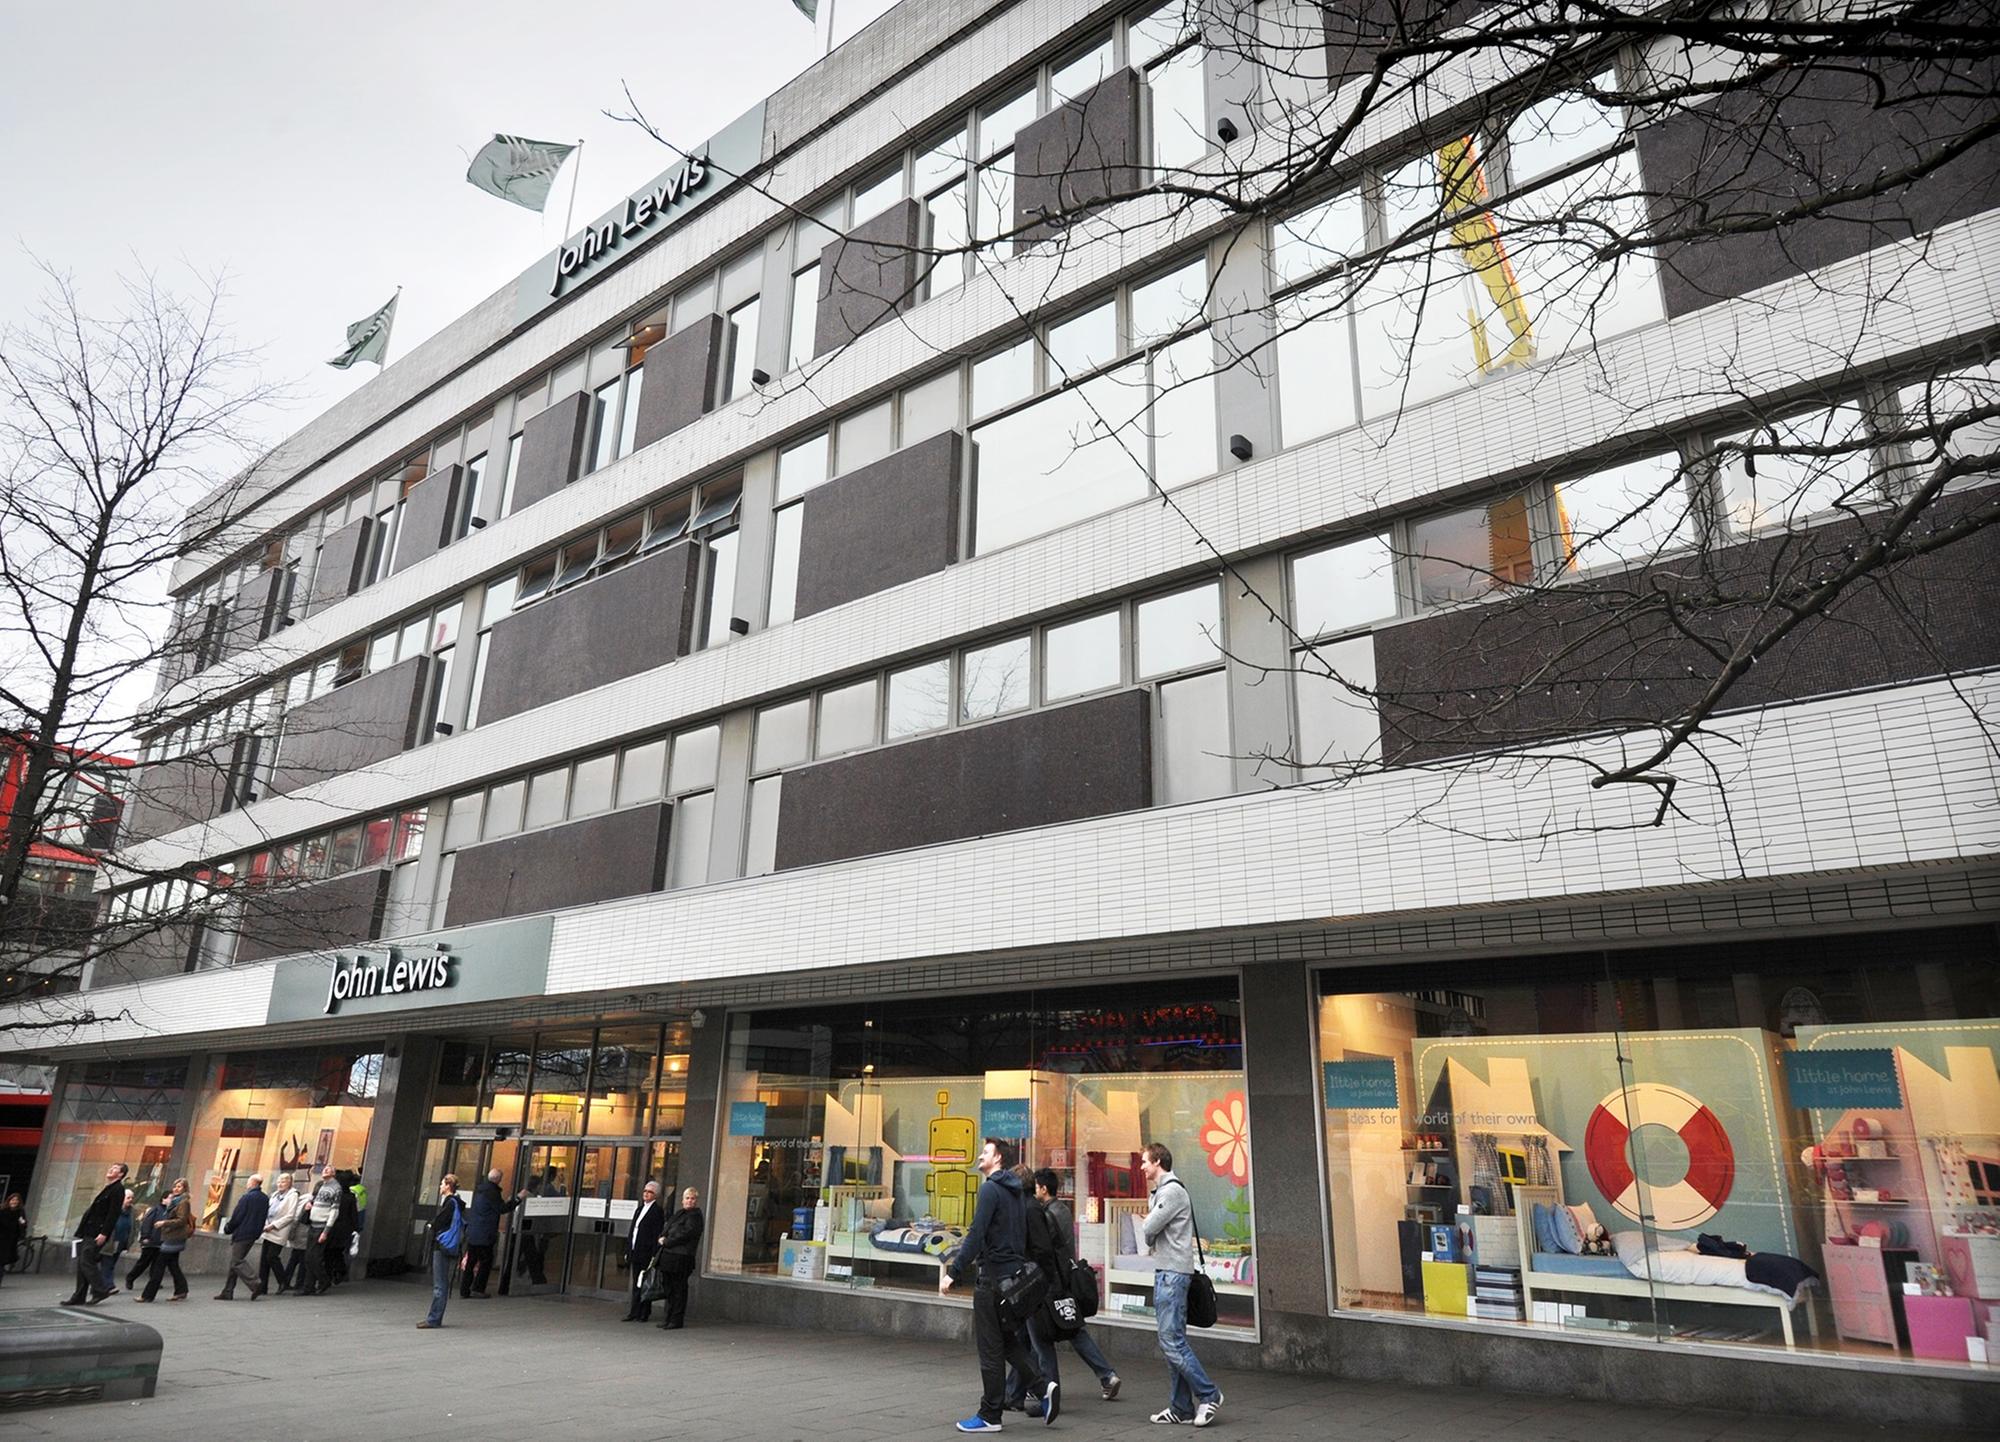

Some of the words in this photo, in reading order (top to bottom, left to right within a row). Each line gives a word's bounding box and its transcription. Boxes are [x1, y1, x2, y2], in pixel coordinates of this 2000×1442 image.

[548, 220, 615, 296] John
[620, 157, 708, 236] Lewis
[322, 954, 379, 1013] John
[381, 942, 450, 994] Lewis
[1330, 1074, 1360, 1089] little
[1361, 1074, 1393, 1089] home
[1793, 1067, 1840, 1083] little
[1842, 1067, 1890, 1083] home
[1380, 1111, 1397, 1125] for
[1412, 1111, 1449, 1125] world
[1454, 1111, 1467, 1125] of
[1470, 1111, 1500, 1125] their
